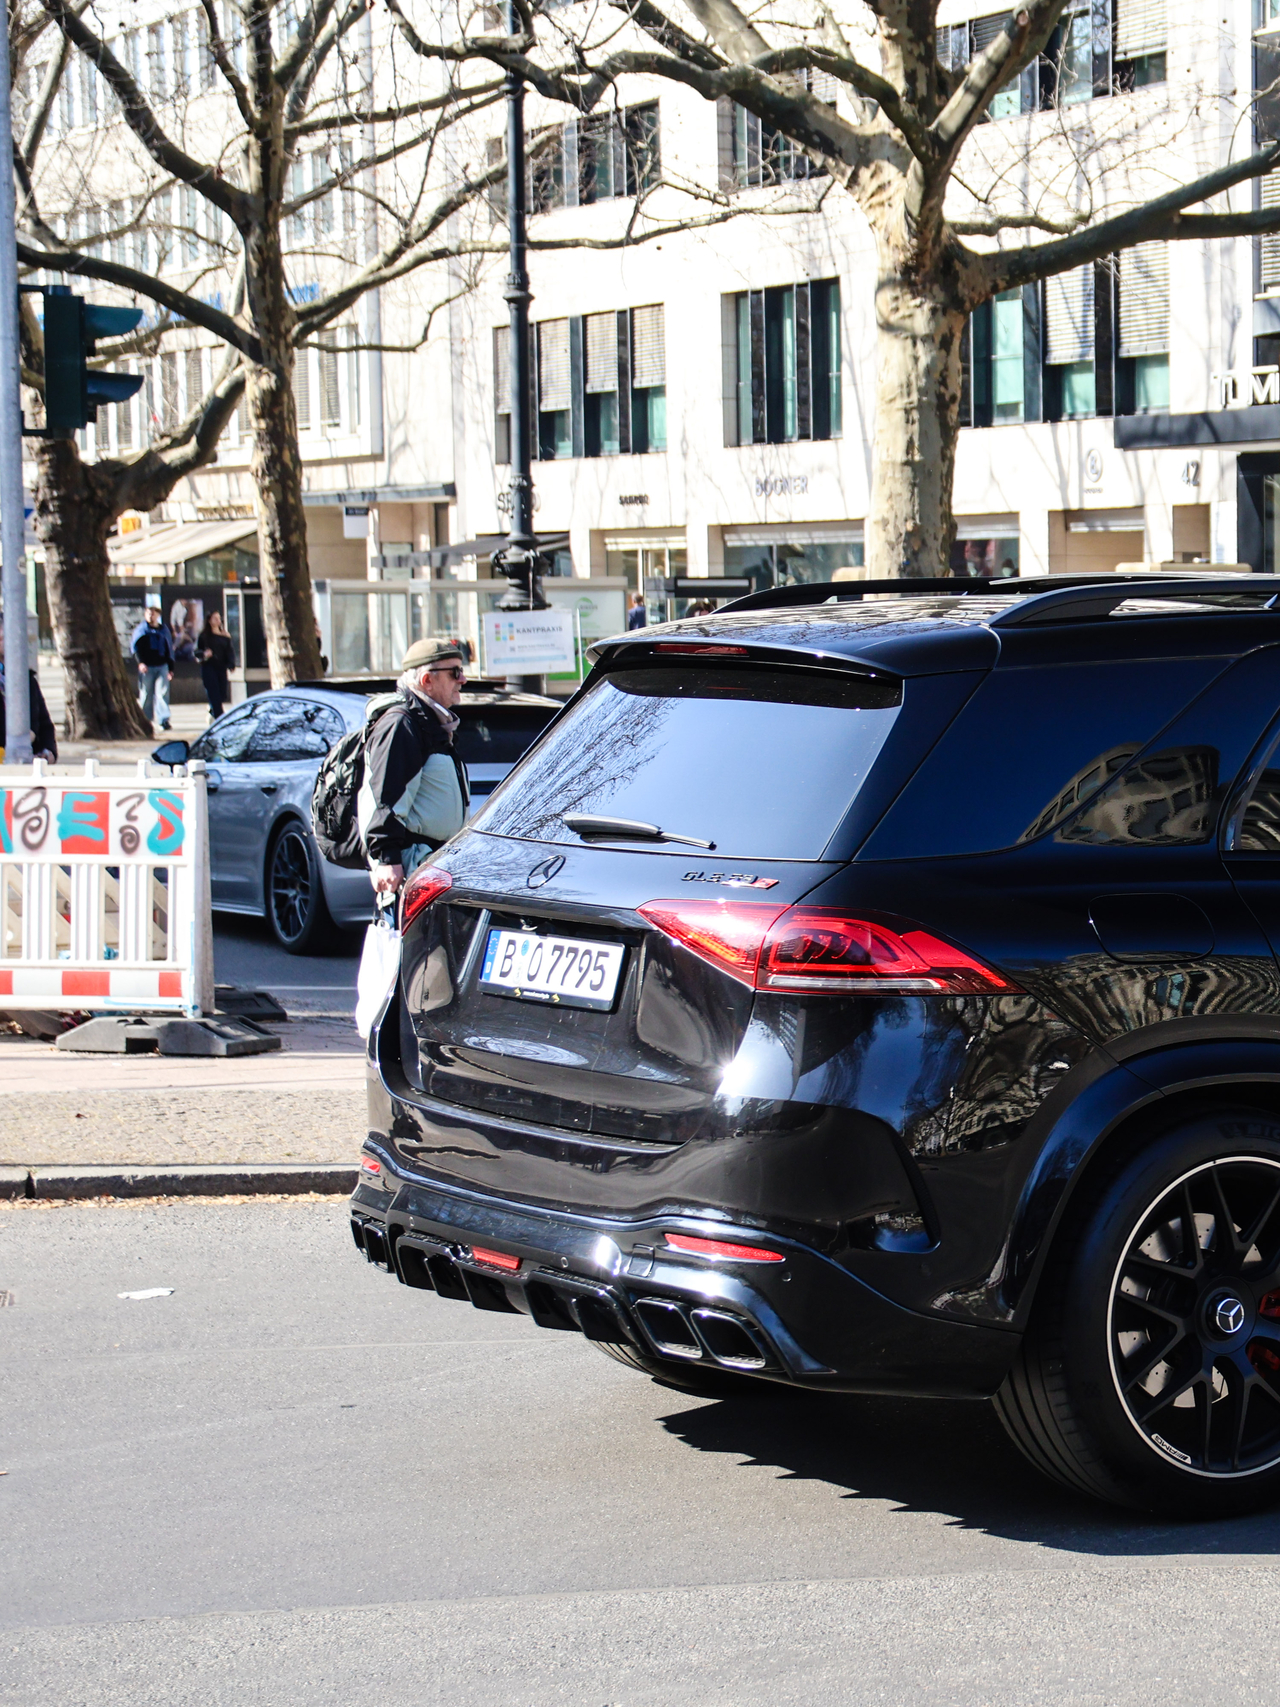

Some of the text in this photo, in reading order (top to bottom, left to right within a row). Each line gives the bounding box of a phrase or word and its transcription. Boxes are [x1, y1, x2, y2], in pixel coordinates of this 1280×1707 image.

[1181, 460, 1200, 487] 42
[755, 476, 809, 497] BOGNER
[516, 626, 563, 634] KANTPRAXIS
[499, 939, 516, 978] B
